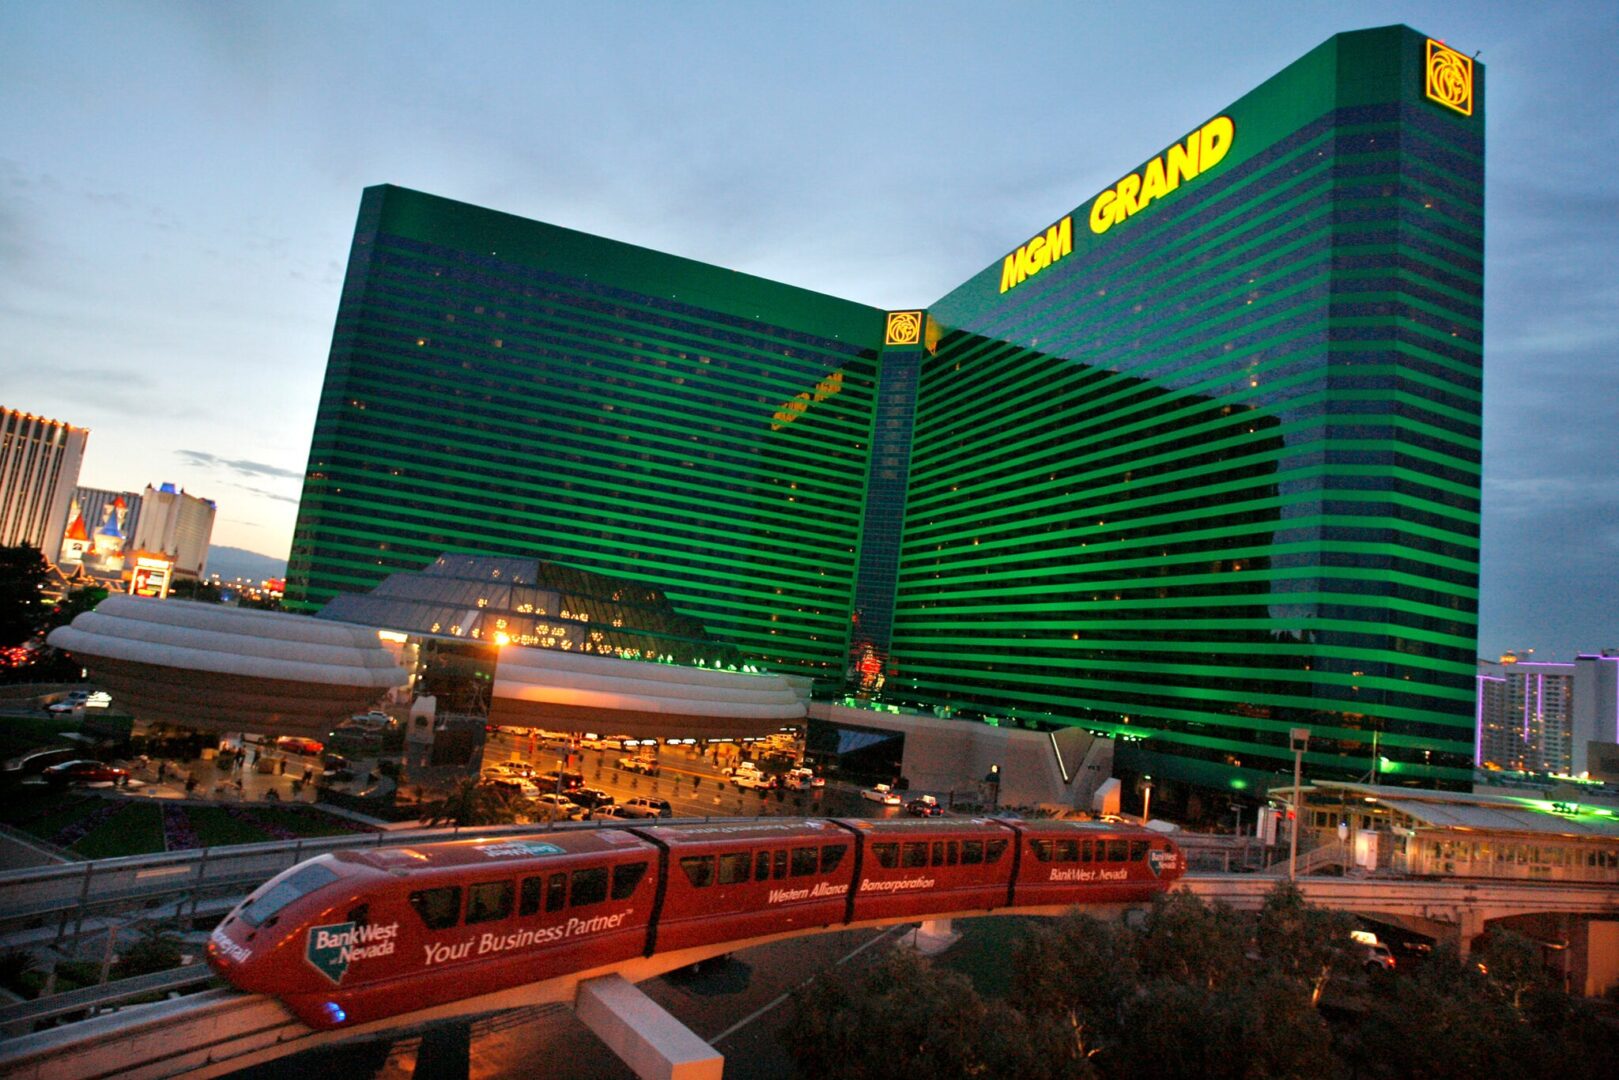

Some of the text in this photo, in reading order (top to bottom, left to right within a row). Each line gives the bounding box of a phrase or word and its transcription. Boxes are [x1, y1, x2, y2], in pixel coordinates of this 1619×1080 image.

[1000, 115, 1235, 294] MGM GRAND
[768, 881, 849, 904] Western Alliance
[860, 875, 935, 893] Bancorporation
[315, 921, 400, 951] BankWest
[423, 939, 475, 966] Your
[477, 924, 565, 955] Business
[338, 939, 395, 964] Nevada
